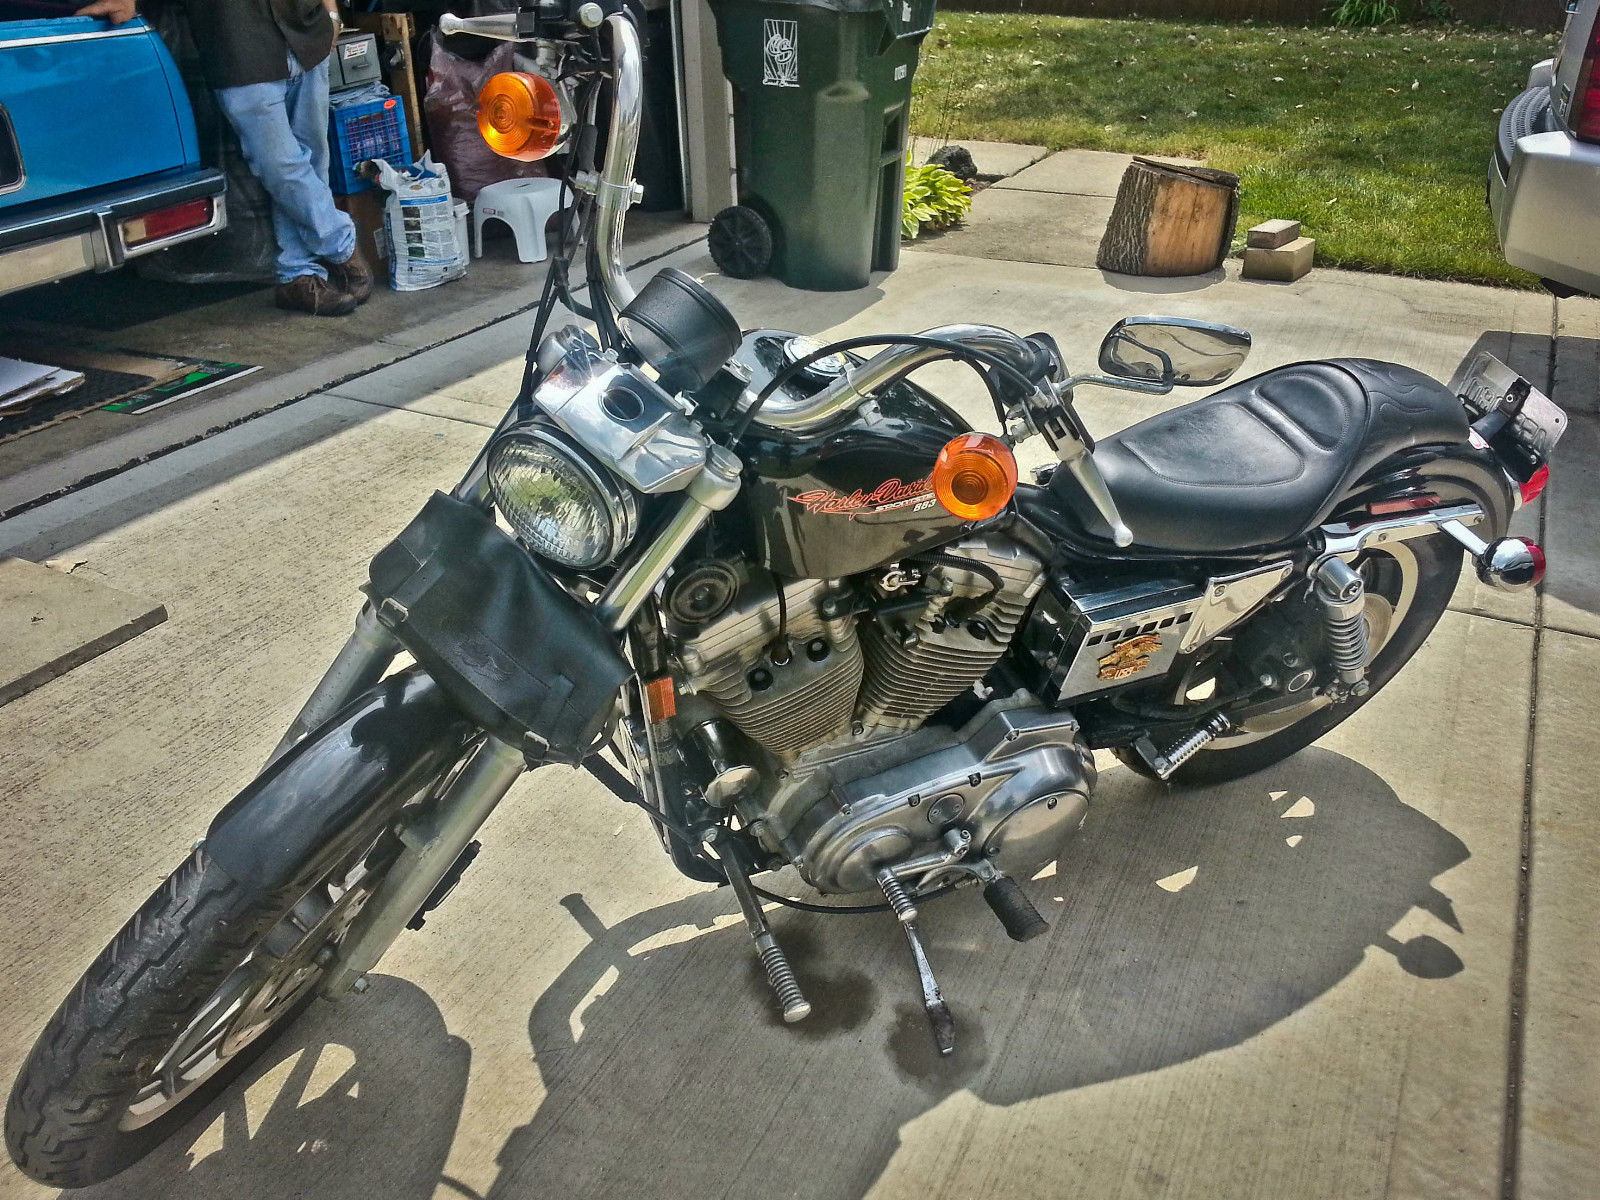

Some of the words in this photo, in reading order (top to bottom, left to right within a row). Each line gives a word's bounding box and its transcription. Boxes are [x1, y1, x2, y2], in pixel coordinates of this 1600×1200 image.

[789, 473, 935, 517] Harley-David
[875, 492, 936, 512] SPORTSTE
[912, 498, 937, 512] 883
